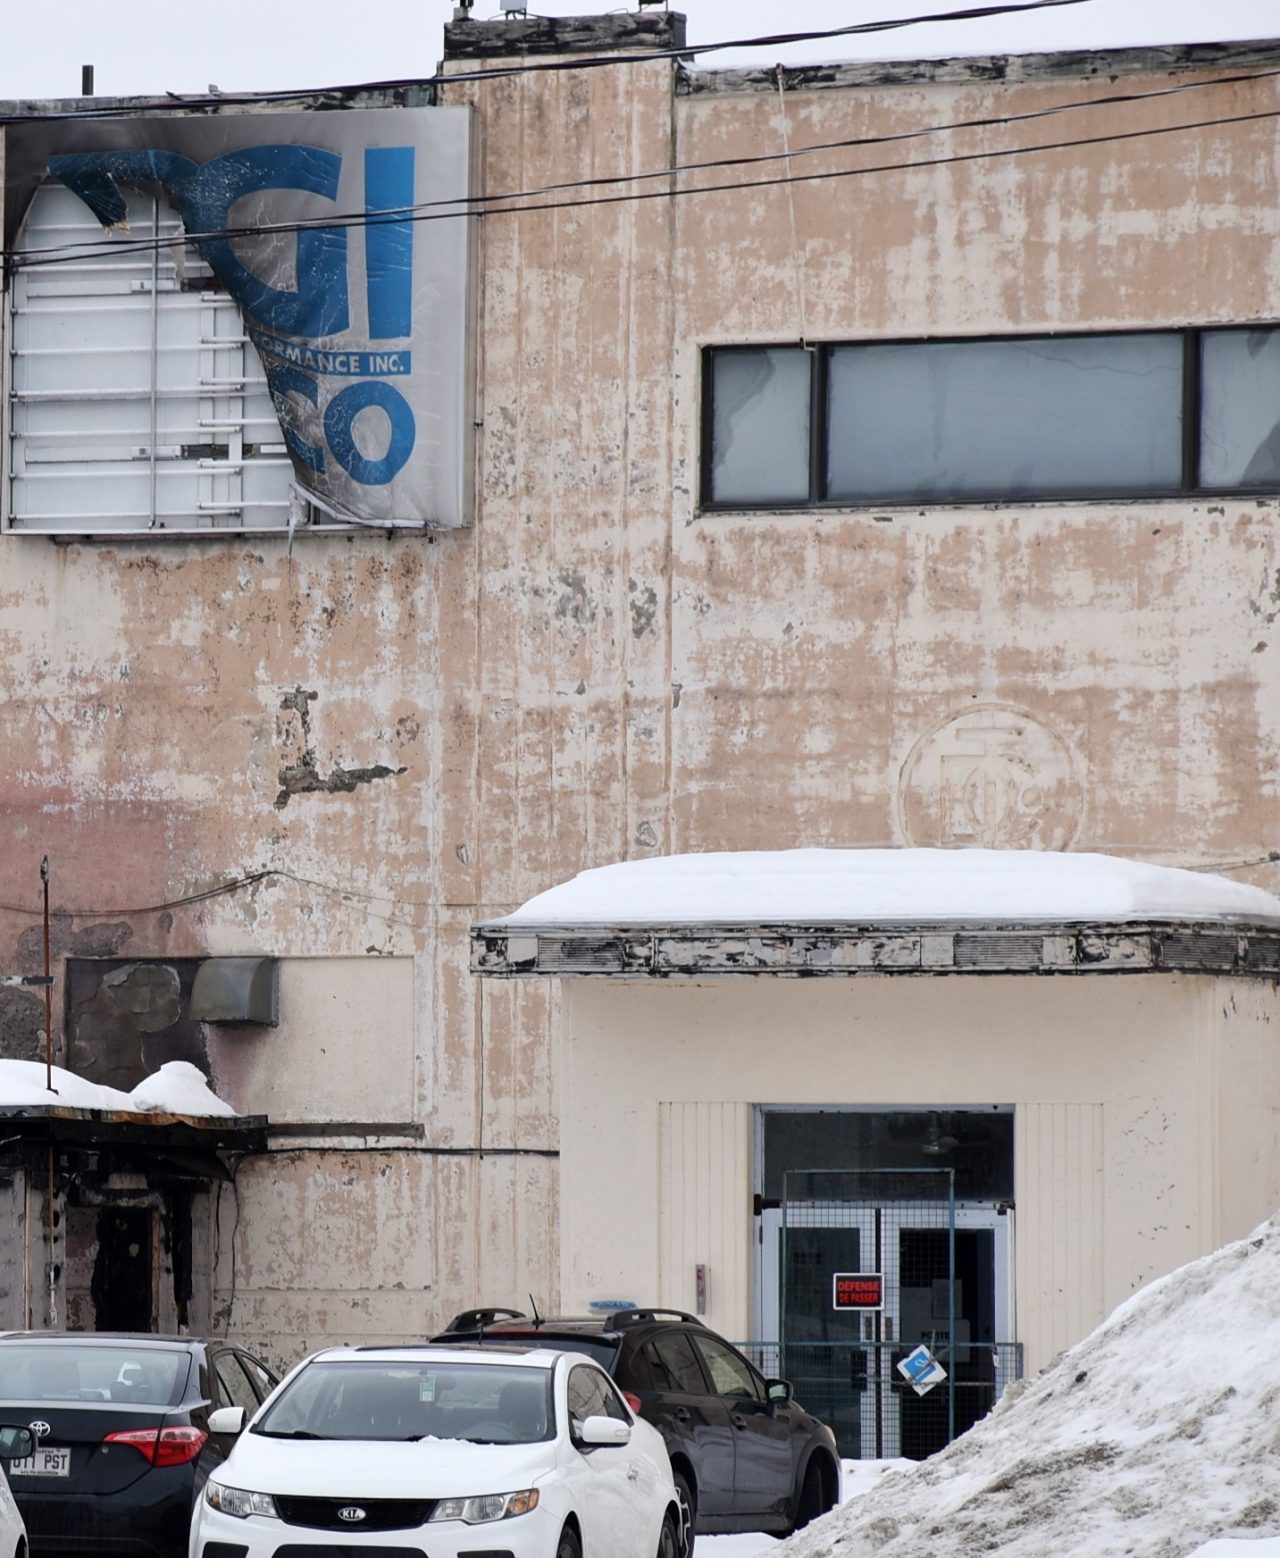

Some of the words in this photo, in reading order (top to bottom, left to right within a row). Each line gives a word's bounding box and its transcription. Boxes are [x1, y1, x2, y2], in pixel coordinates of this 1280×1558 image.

[258, 335, 360, 373] ORMANCE
[370, 354, 404, 372] INC.
[839, 1293, 849, 1303] DE
[851, 1293, 878, 1303] PASSER
[44, 1454, 68, 1470] PST
